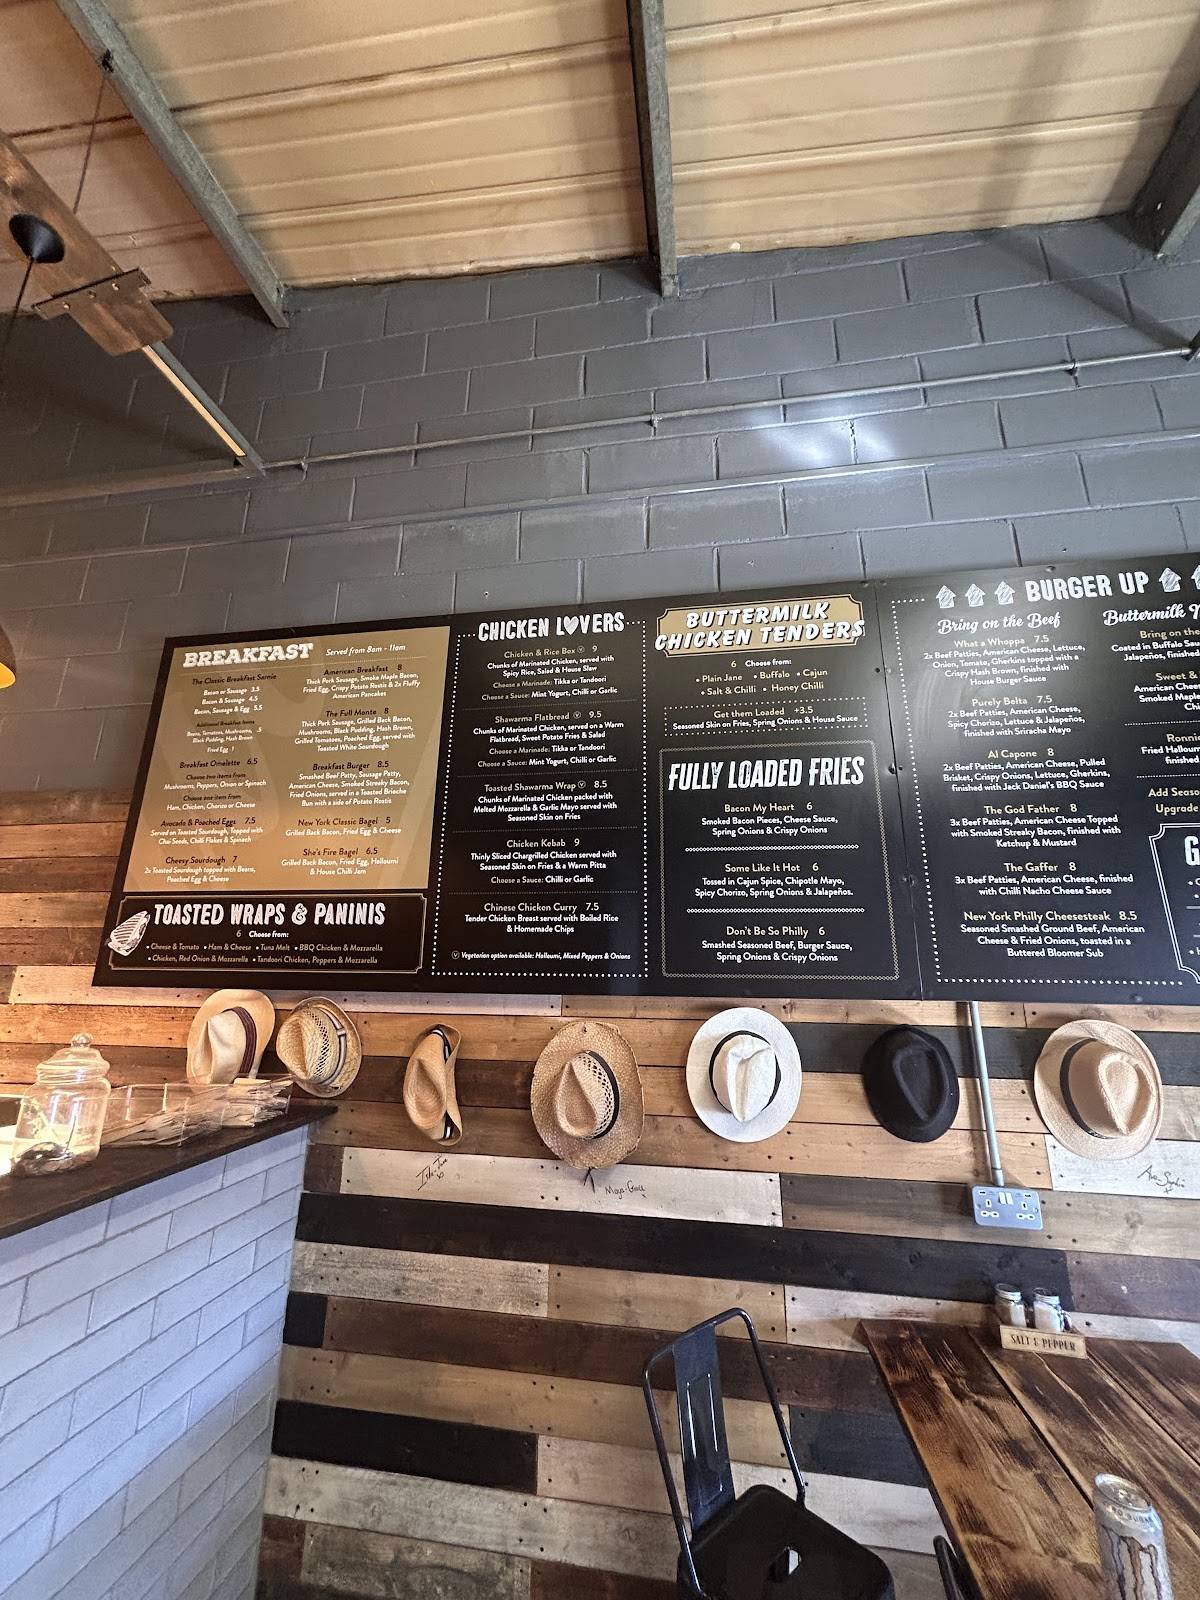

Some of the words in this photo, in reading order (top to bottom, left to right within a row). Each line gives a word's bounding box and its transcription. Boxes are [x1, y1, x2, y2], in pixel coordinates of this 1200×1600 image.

[1025, 575, 1112, 602] BURGER
[1118, 571, 1149, 595] UP
[687, 602, 828, 629] BUTTERMILK
[1103, 604, 1186, 626] Buttermilk
[479, 618, 549, 642] CHICKEN
[938, 619, 979, 635] Bring
[1003, 615, 1024, 628] the
[1027, 612, 1060, 629] Beef
[655, 629, 751, 652] CHICKEN
[760, 619, 864, 644] TENDERS
[954, 640, 978, 648] What
[987, 637, 1025, 648] Whoppa
[1034, 635, 1049, 643] 7.5
[1140, 630, 1167, 640] Bring
[183, 643, 313, 668] BREAKFAST
[326, 647, 348, 656] Served
[349, 647, 365, 657] from
[504, 650, 533, 659] Chicken
[772, 658, 791, 666] from:
[702, 675, 722, 683] Plain
[760, 671, 790, 679] Buffalo
[803, 669, 828, 679] Cajun
[707, 687, 723, 696] Salt
[734, 685, 756, 694] Chilli
[772, 684, 799, 693] Honey
[801, 682, 824, 690] Chilli
[972, 698, 1001, 708] Purely
[1004, 697, 1027, 705] Belta
[1037, 695, 1052, 704] 7.5
[495, 716, 532, 724] Shawarma
[535, 712, 569, 721] Flatbread
[589, 711, 601, 719] 9.5
[714, 711, 729, 719] Get
[731, 710, 753, 718] them
[755, 707, 784, 717] Loaded
[794, 706, 813, 714] +3.5
[673, 722, 704, 730] Seasoned
[706, 721, 721, 729] Skin
[753, 719, 776, 728] Spring
[836, 715, 858, 723] Sauce
[988, 750, 998, 759] Al
[1001, 750, 1037, 761] Capone
[668, 762, 724, 791] FULLY
[728, 759, 802, 789] LOADED
[809, 756, 865, 786] FRIES
[484, 784, 512, 792] Toasted
[515, 783, 553, 791] Shawarma
[555, 782, 576, 792] Wrap
[594, 780, 607, 789] 8.5
[725, 804, 750, 813] Bacon
[753, 804, 767, 815] My
[770, 803, 795, 811] Heart
[984, 806, 1002, 815] The
[1005, 805, 1025, 814] God
[1027, 804, 1059, 813] Father
[1156, 803, 1198, 816] Upgrade
[507, 840, 539, 848] Chicken
[541, 839, 566, 847] Kebab
[725, 864, 750, 873] Some
[752, 863, 770, 872] Like
[773, 863, 780, 872] It
[783, 863, 800, 872] Hot
[1004, 863, 1023, 872] The
[1025, 862, 1058, 872] Gaffer
[155, 904, 224, 925] TOASTED
[231, 903, 285, 925] WRAPS
[314, 903, 386, 925] PANINIS
[484, 903, 516, 912] Chinese
[518, 903, 551, 911] Chicken
[553, 903, 577, 914] Curry
[586, 903, 599, 911] 7.5
[465, 914, 487, 922] Tender
[488, 914, 516, 922] Chicken
[518, 914, 539, 922] Breast
[540, 914, 562, 922] served
[563, 914, 578, 922] with
[580, 914, 601, 922] Boiled
[603, 914, 619, 922] Rice
[964, 912, 986, 921] New
[988, 911, 1012, 921] York
[1014, 911, 1043, 924] Philly
[1046, 911, 1111, 921] Cheesesteak
[1119, 911, 1137, 921] 8.5
[727, 926, 751, 936] Don't
[754, 926, 765, 936] Be
[768, 926, 779, 936] So
[782, 926, 808, 939] Philly
[1042, 1338, 1076, 1351] PEPPER
